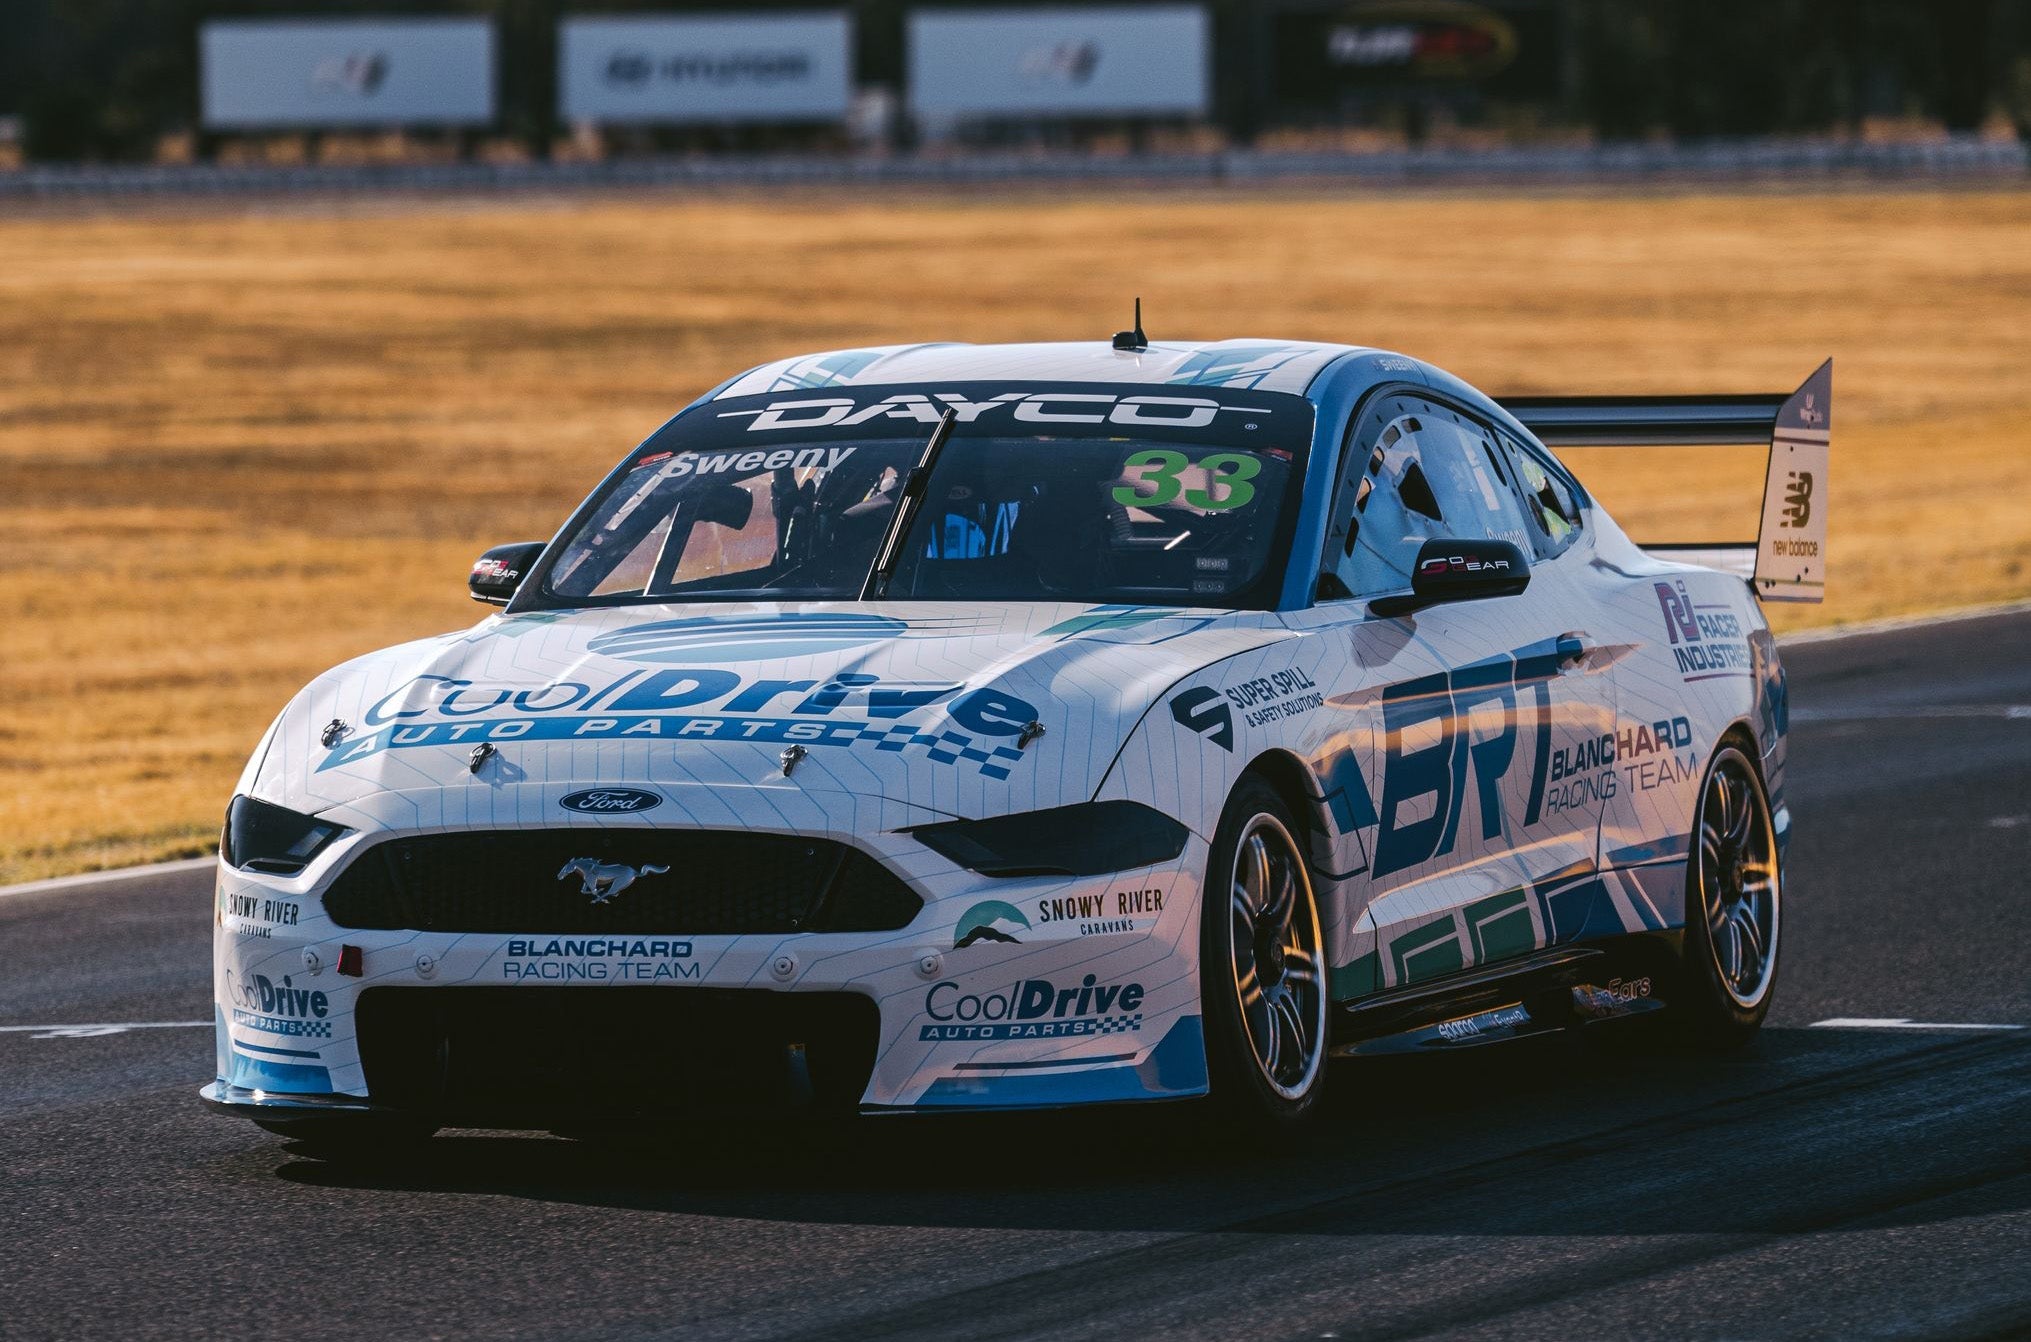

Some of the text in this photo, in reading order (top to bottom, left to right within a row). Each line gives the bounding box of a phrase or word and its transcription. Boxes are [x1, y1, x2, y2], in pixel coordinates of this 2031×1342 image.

[747, 393, 1220, 431] DAYCO
[661, 447, 857, 477] Sweeny
[1112, 450, 1262, 509] 33
[1773, 537, 1818, 557] new balance
[364, 669, 1039, 737] CoolDrive
[1225, 666, 1316, 709] SUPER SPILL
[1245, 692, 1324, 728] & SAFETY SOLUTIONS
[340, 718, 827, 761] AUTO PARTS
[1551, 715, 1692, 782] BLANCHARD
[1371, 636, 1560, 881] BRT
[578, 791, 643, 810] Ford
[1546, 752, 1698, 818] RACING TEAM
[229, 893, 299, 926] SNOWY RIVER
[1039, 889, 1163, 922] SNOWY RIVER
[239, 922, 272, 939] CARAVANS
[1081, 920, 1134, 935] CARAVANS
[508, 940, 693, 957] BLANCHARD
[504, 962, 700, 979] RACING TEAM
[226, 969, 329, 1018] CoolDrive
[925, 974, 1144, 1022] CoolDrive
[234, 1011, 296, 1033] AUTO PARTS
[926, 1022, 1086, 1038] AUTO PARTS
